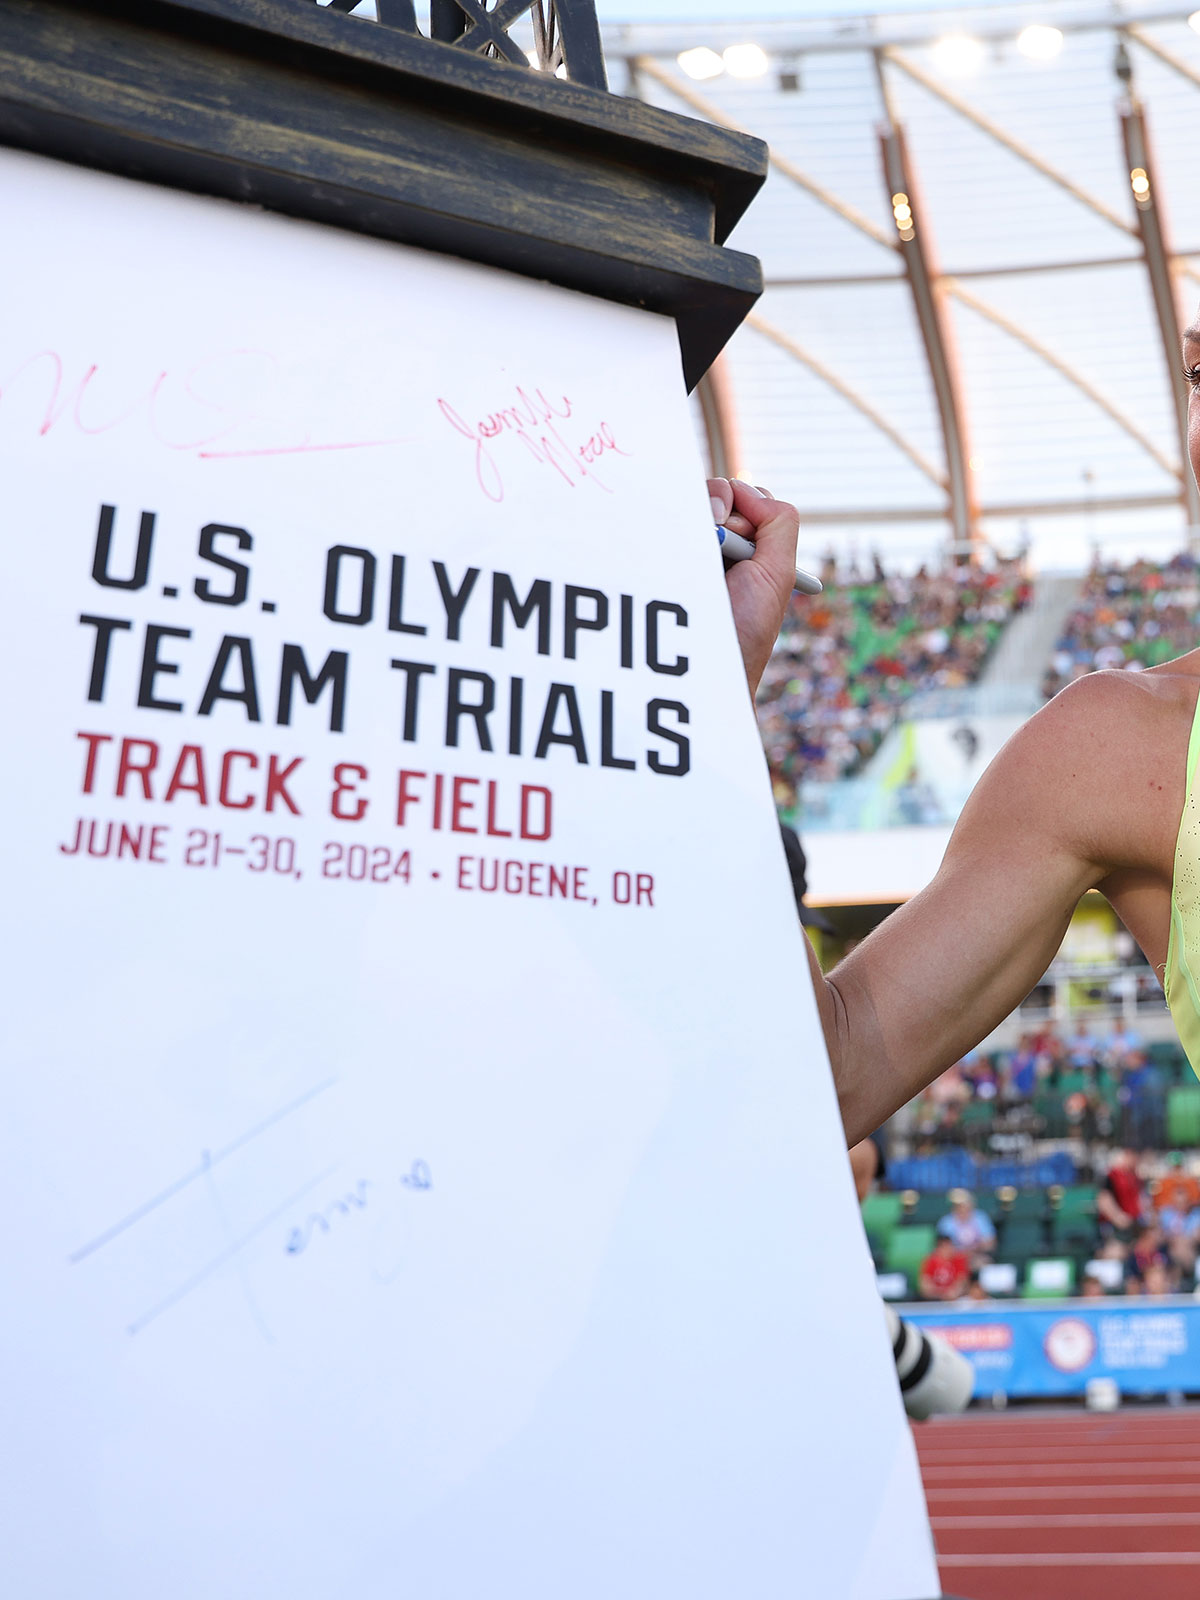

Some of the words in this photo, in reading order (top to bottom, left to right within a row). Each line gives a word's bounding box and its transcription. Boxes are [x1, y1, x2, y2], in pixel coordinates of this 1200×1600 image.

[91, 503, 276, 614] U.S.
[322, 544, 690, 677] OLYMPIC
[78, 613, 349, 733] TEAM
[390, 659, 691, 777] TRIALS
[75, 731, 305, 817] TRACK
[330, 762, 369, 822] &
[395, 769, 554, 842] FIELD
[59, 817, 170, 864] JUNE
[322, 841, 412, 884] 2024
[457, 855, 598, 907] EUGENE,
[612, 871, 655, 907] OR
